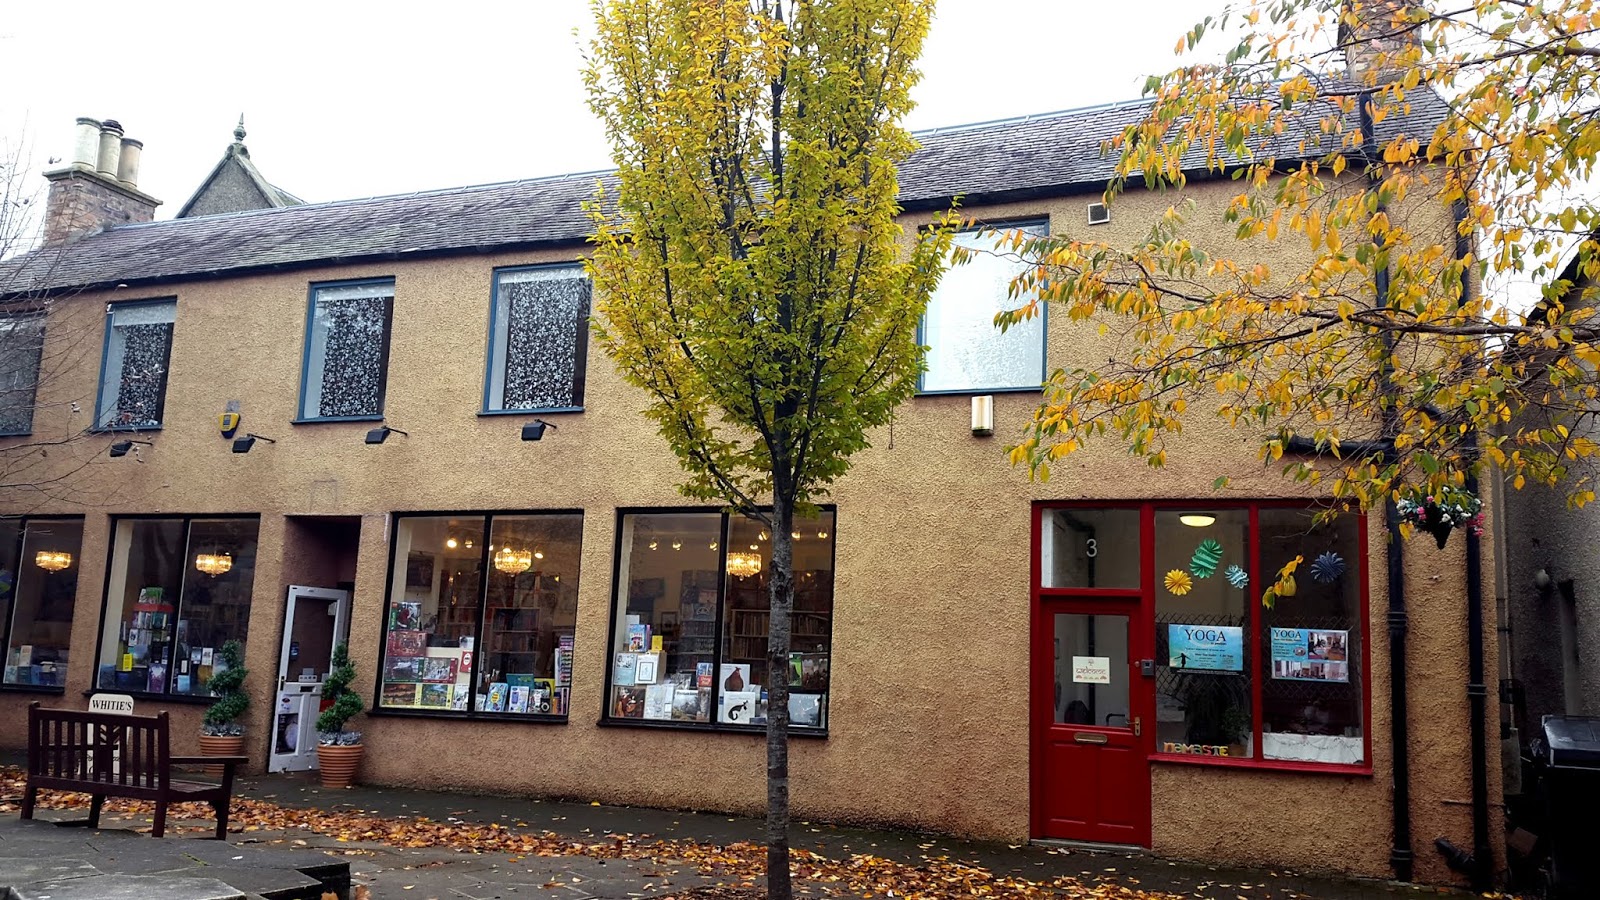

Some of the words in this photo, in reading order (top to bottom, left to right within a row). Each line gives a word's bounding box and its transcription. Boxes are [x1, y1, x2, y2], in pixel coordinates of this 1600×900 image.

[1086, 538, 1098, 558] 3
[1185, 629, 1227, 642] YOGA
[1273, 629, 1302, 639] YOGA
[92, 699, 133, 711] WHITIE'S
